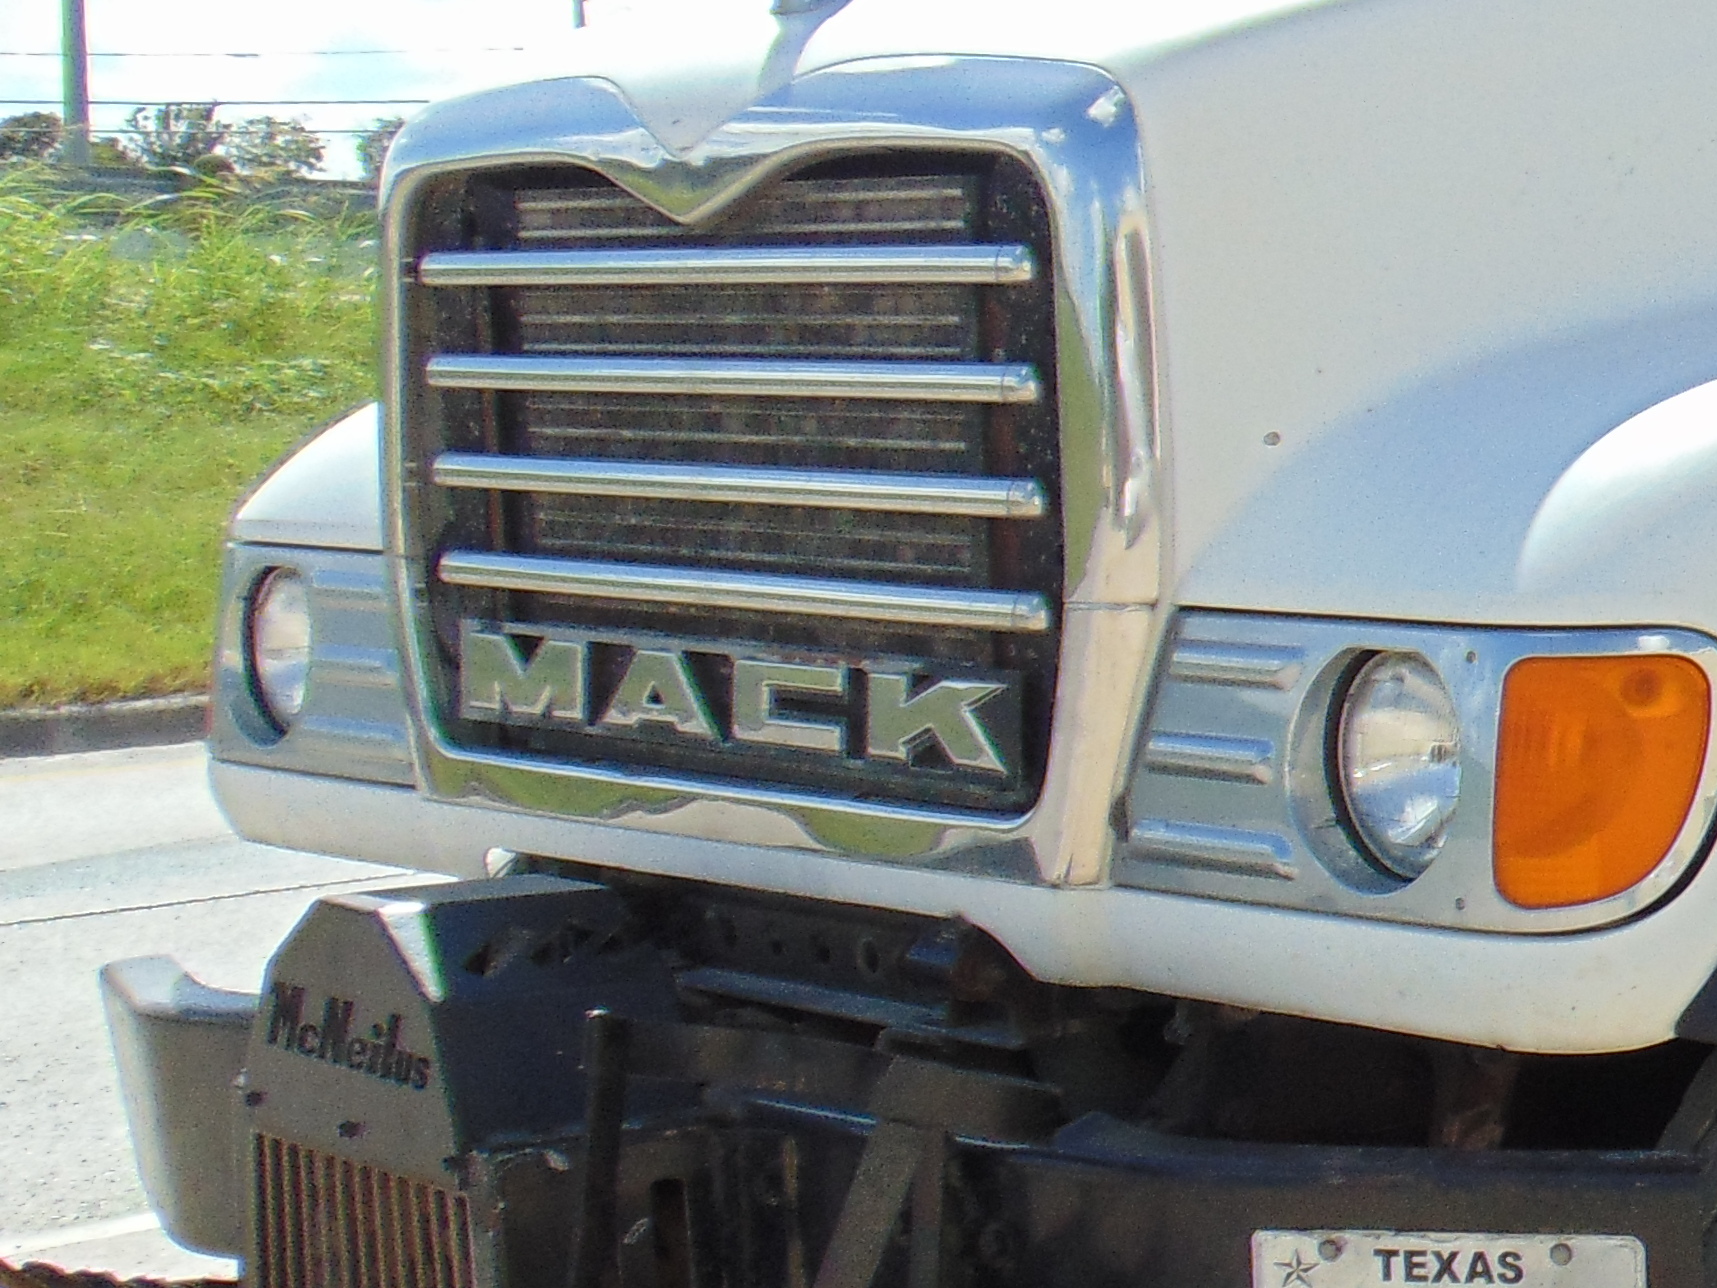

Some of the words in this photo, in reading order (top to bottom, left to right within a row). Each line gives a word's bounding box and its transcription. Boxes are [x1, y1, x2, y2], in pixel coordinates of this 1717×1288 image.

[459, 631, 1008, 775] MACK
[267, 982, 430, 1089] McNeilus
[1372, 1248, 1524, 1285] TEXAS
